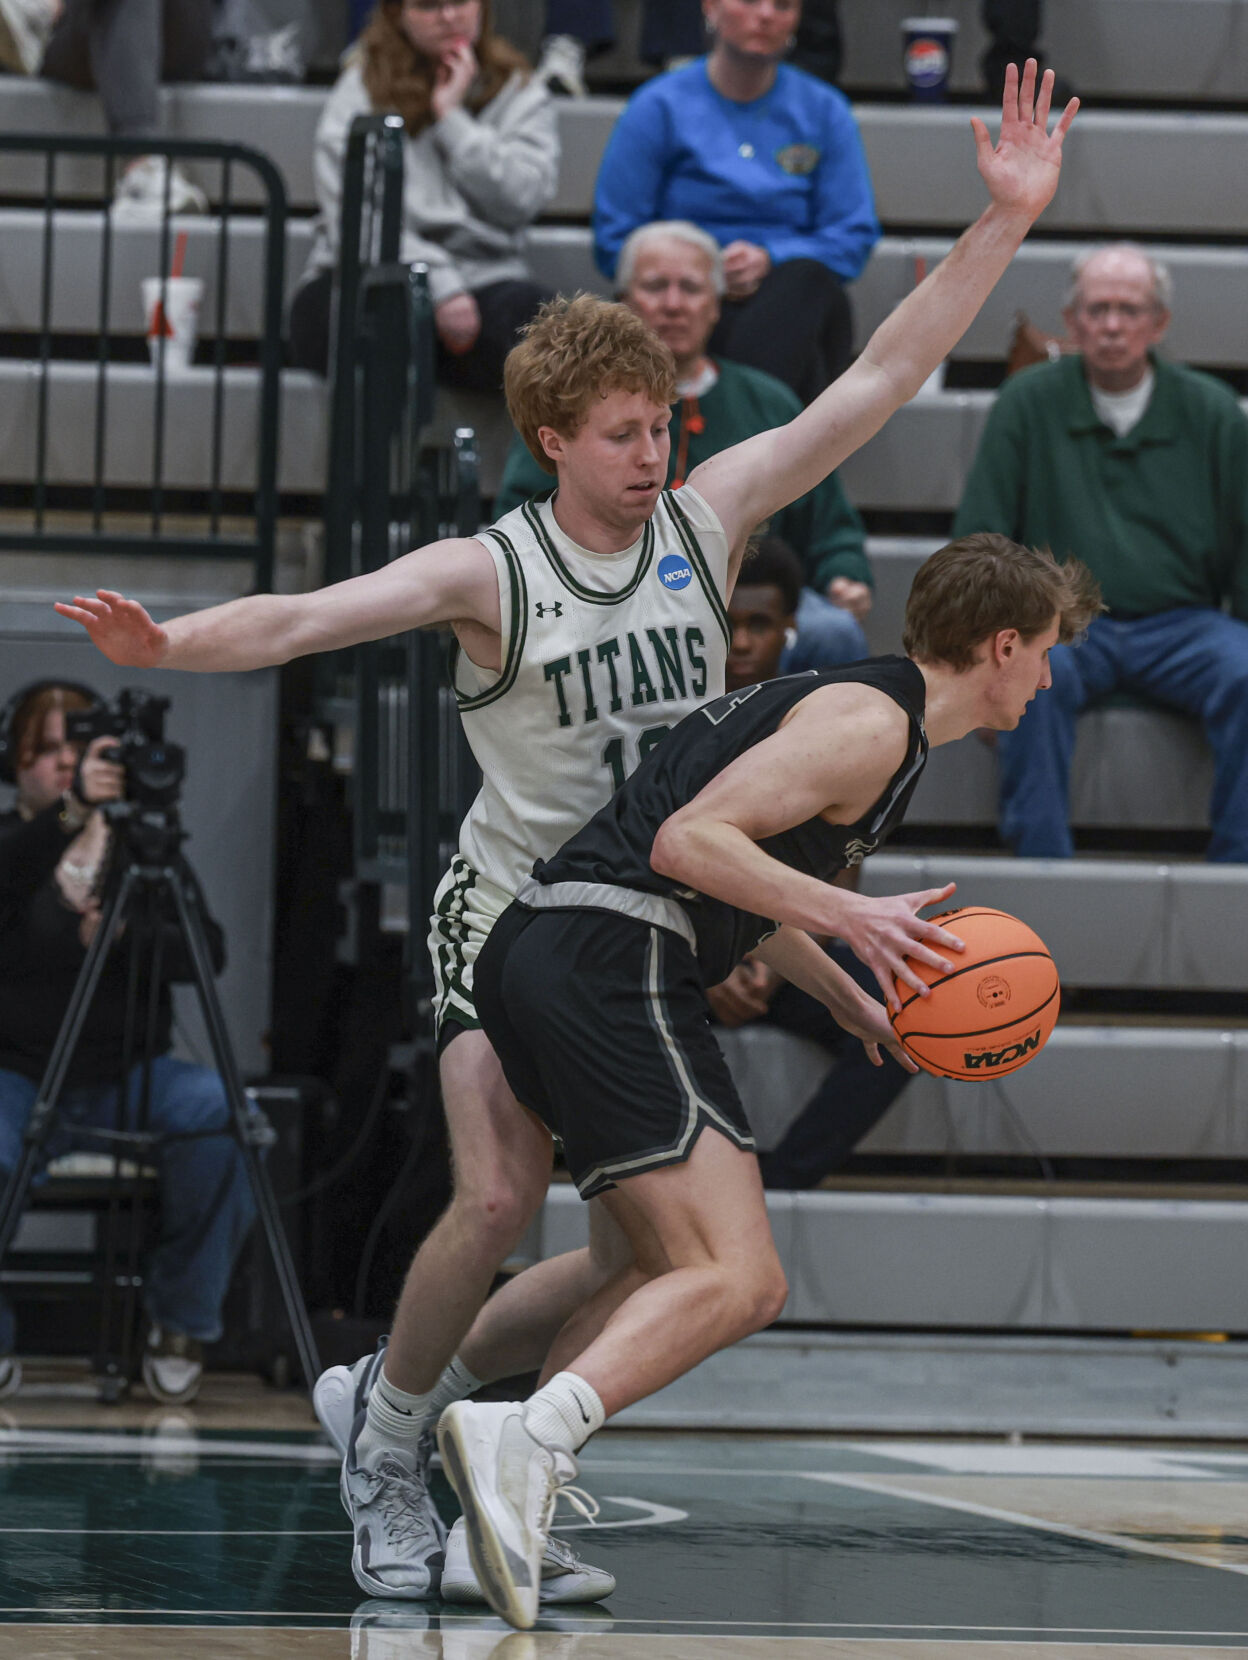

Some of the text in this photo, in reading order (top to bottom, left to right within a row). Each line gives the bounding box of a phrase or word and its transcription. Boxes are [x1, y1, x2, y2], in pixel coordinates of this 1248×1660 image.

[663, 568, 691, 583] NCAA
[543, 626, 708, 728] TITANS
[964, 1029, 1041, 1069] NCAA
